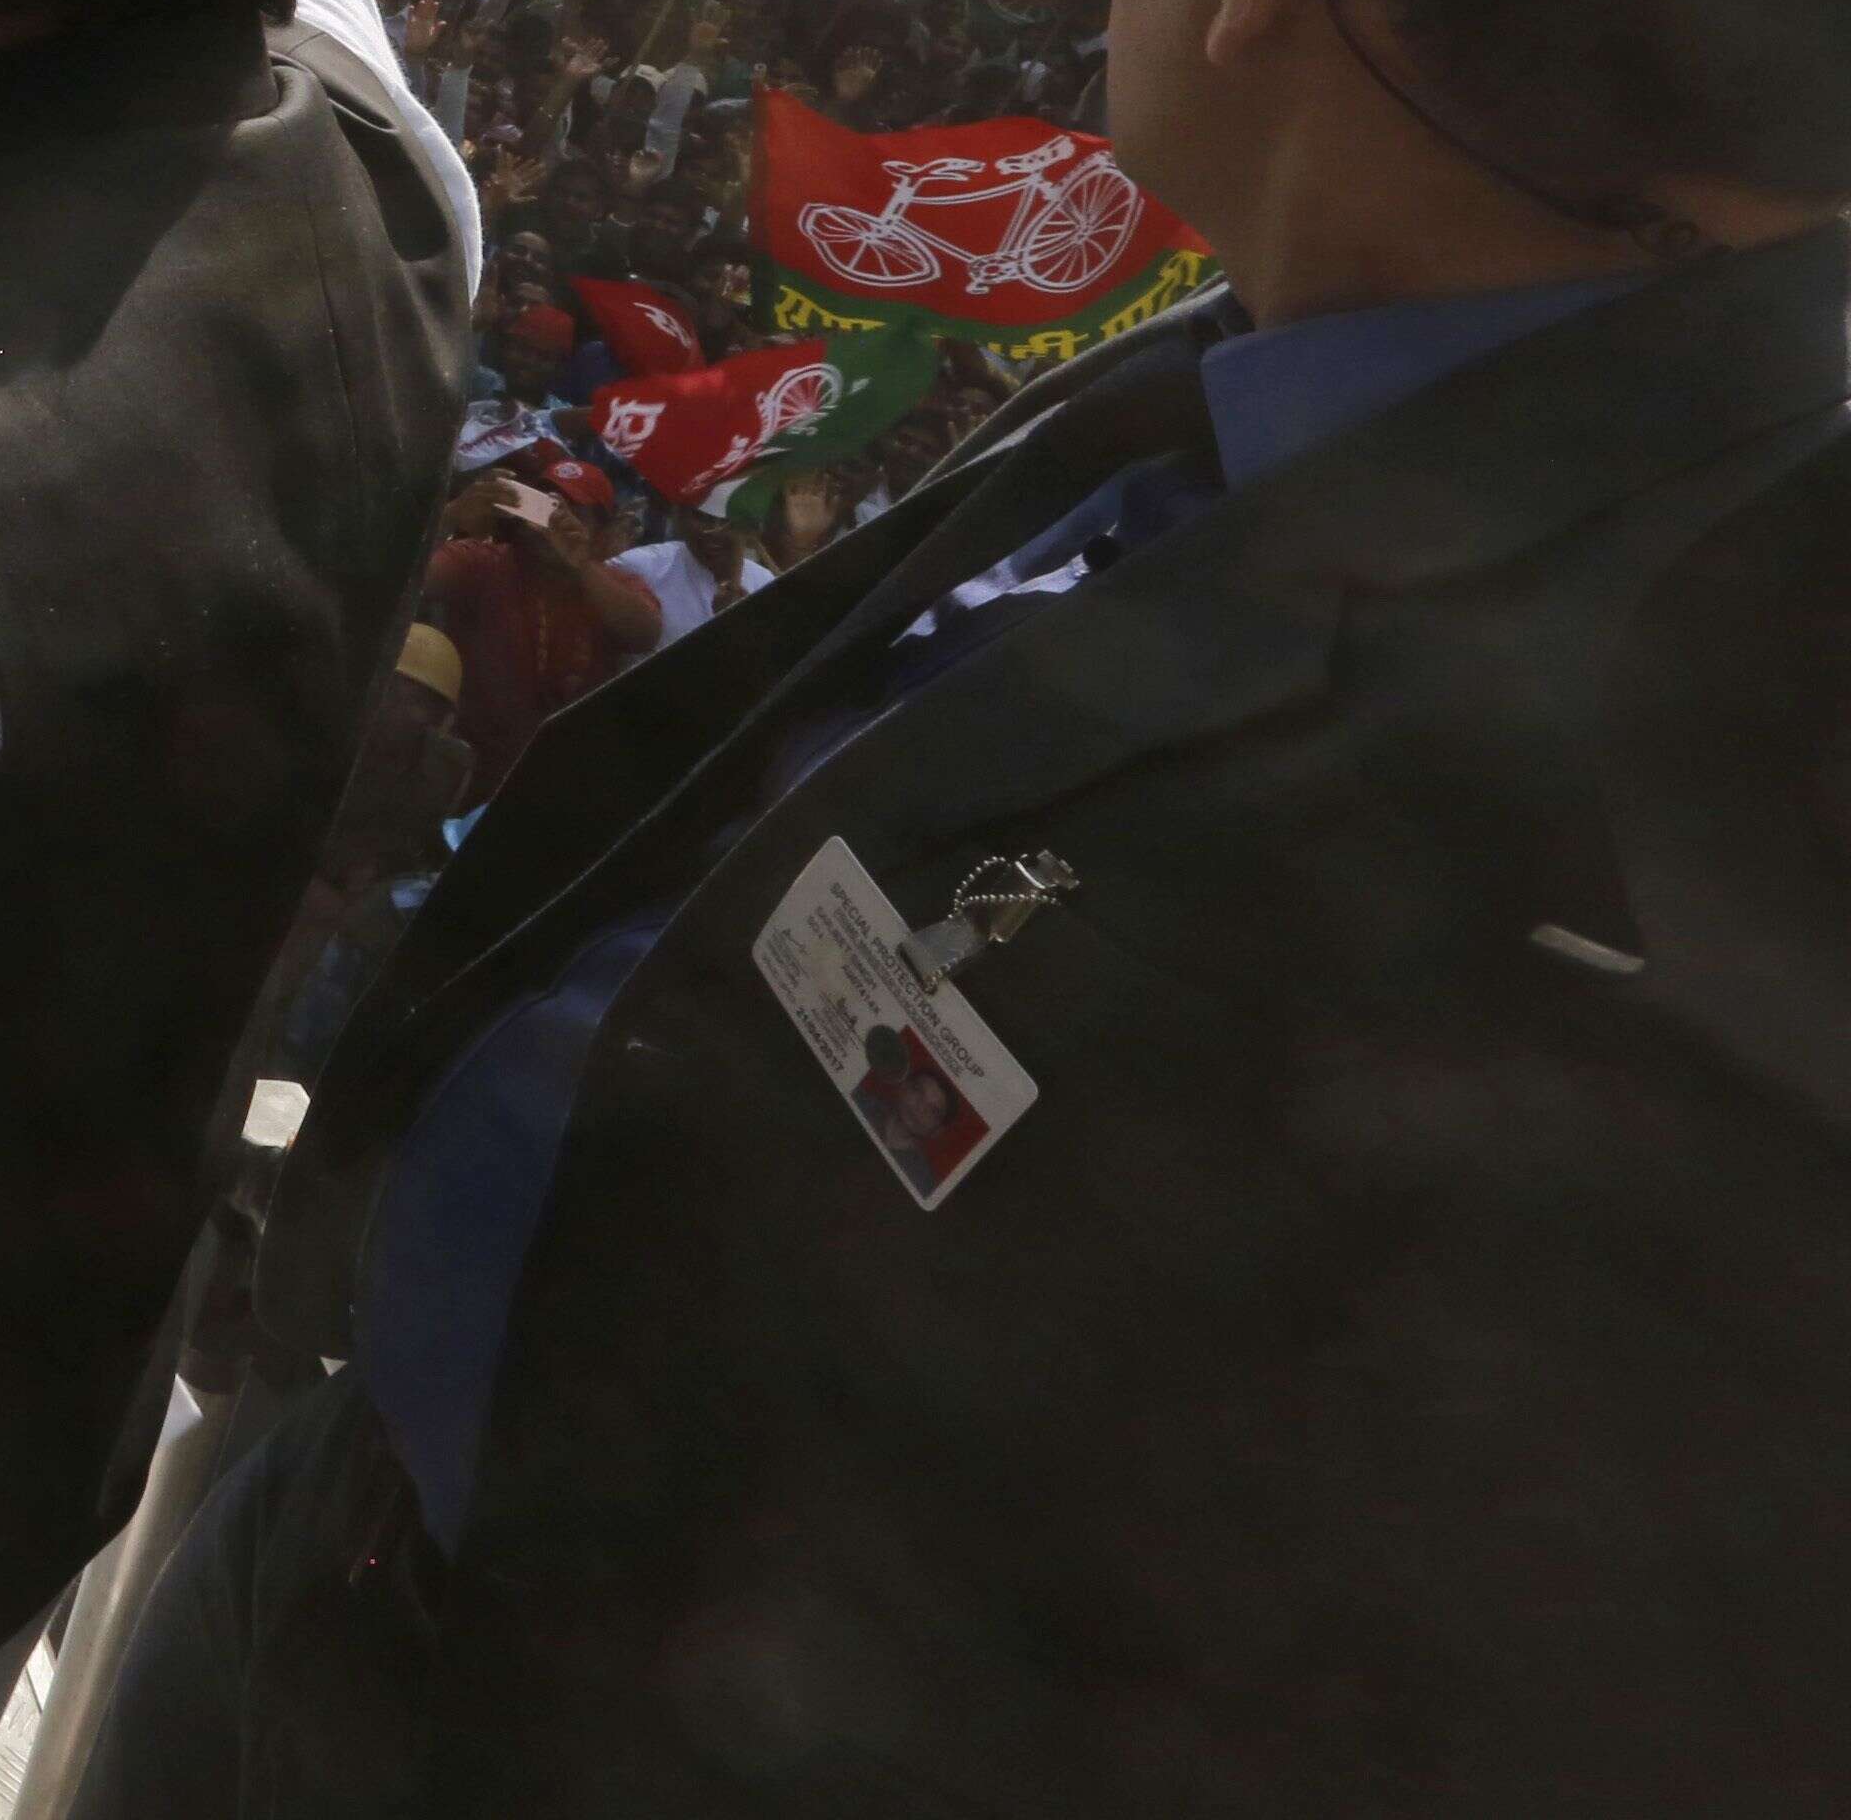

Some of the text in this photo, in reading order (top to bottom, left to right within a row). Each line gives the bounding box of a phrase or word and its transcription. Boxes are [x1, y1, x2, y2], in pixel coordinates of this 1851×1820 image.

[829, 880, 872, 937] SPECIAL
[870, 934, 941, 1028] PROTECTION
[939, 1023, 984, 1083] GROUP
